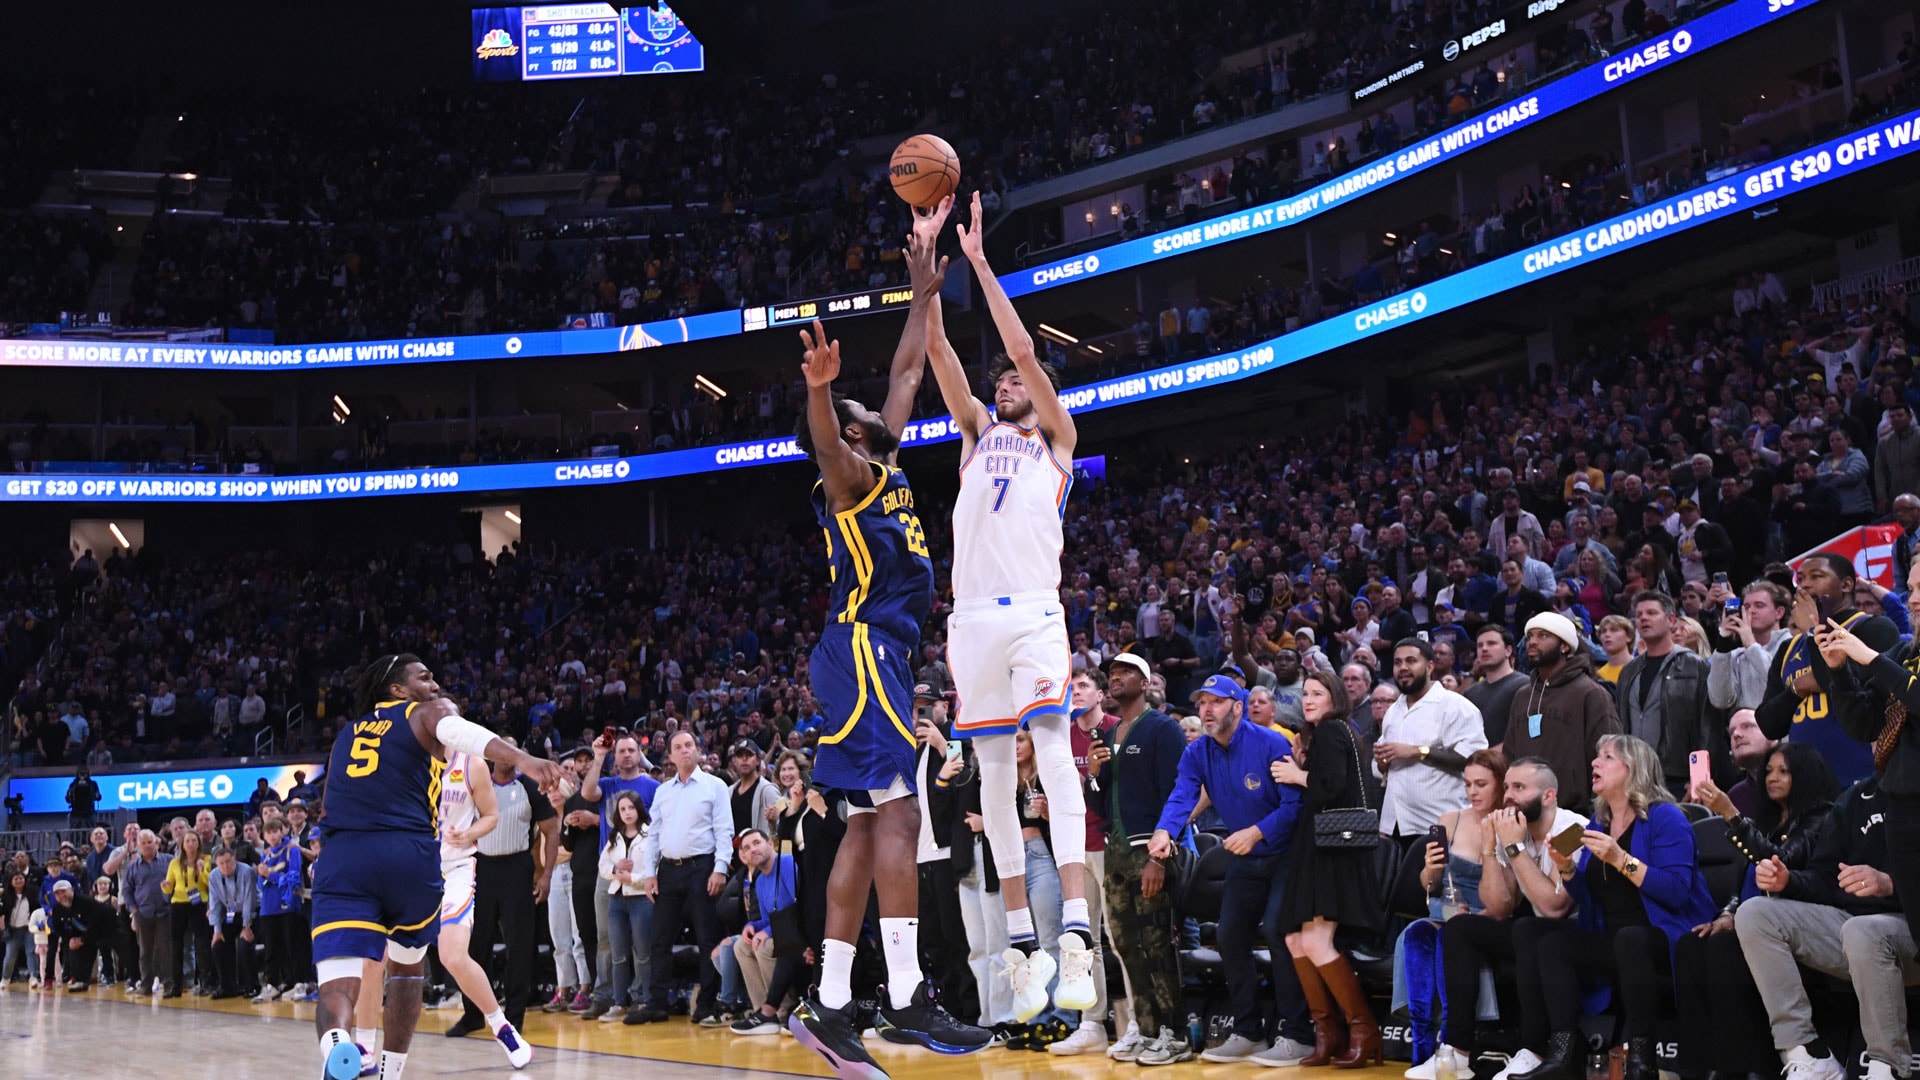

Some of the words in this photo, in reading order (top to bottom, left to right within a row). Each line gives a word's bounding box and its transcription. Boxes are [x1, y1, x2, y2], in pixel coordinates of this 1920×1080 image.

[547, 9, 567, 18] SHOT
[570, 6, 606, 17] TRACKER
[528, 29, 540, 37] FG
[1463, 20, 1505, 50] PEPSI
[476, 46, 519, 60] Sports
[528, 63, 539, 72] FT
[551, 58, 577, 72] 17/21
[1605, 40, 1670, 81] CHASE
[1356, 79, 1387, 98] FOUNDING
[1389, 61, 1423, 82] PARTNERS
[1154, 229, 1201, 253] SCORE
[1204, 216, 1249, 240] MORE
[1253, 209, 1273, 227] AT
[1277, 193, 1319, 221] EVERY
[1321, 161, 1394, 203] WARRIORS
[1397, 141, 1440, 171] GAME
[1442, 122, 1483, 152] WITH
[1486, 98, 1538, 132] CHASE
[1524, 238, 1582, 272] CHASE
[1586, 186, 1736, 251] CARDHOLDERS:
[1745, 166, 1785, 196] GET
[1791, 151, 1831, 182] $20
[1837, 133, 1880, 165] OFF
[1034, 261, 1083, 285] CHASE
[775, 307, 798, 320] MEM
[799, 303, 817, 318] 120
[828, 299, 851, 312] SAS
[882, 291, 912, 304] FINA
[1356, 299, 1409, 330] CHASE
[5, 345, 64, 360] SCORE
[68, 346, 122, 361] MORE
[124, 347, 149, 363] AT
[152, 348, 207, 363] EVERY
[211, 350, 302, 364] WARRIORS
[306, 347, 352, 363] GAME
[356, 345, 399, 360] WITH
[403, 342, 454, 358] CHASE
[1058, 390, 1095, 413] SHOP
[1098, 378, 1146, 401] WHEN
[1149, 370, 1183, 390] YOU
[1186, 358, 1239, 382] SPEND
[1242, 347, 1273, 370] $100
[716, 445, 764, 464] CHASE
[767, 441, 805, 457] CAR
[901, 426, 918, 441] ET
[921, 422, 946, 439] $20
[556, 464, 613, 480] CHASE
[985, 455, 1021, 475] CITY
[7, 480, 42, 495] GET
[46, 480, 77, 496] $20
[82, 481, 115, 495] OFF
[120, 481, 216, 496] WARRIORS
[221, 482, 267, 496] SHOP
[271, 480, 321, 495] WHEN
[326, 477, 360, 492] YOU
[365, 474, 417, 490] SPEND
[421, 472, 458, 488] $100
[990, 476, 1012, 514] 7
[899, 513, 930, 558] 22
[346, 737, 381, 778] 5
[119, 779, 205, 801] CHASE
[1209, 1015, 1235, 1028] CHA
